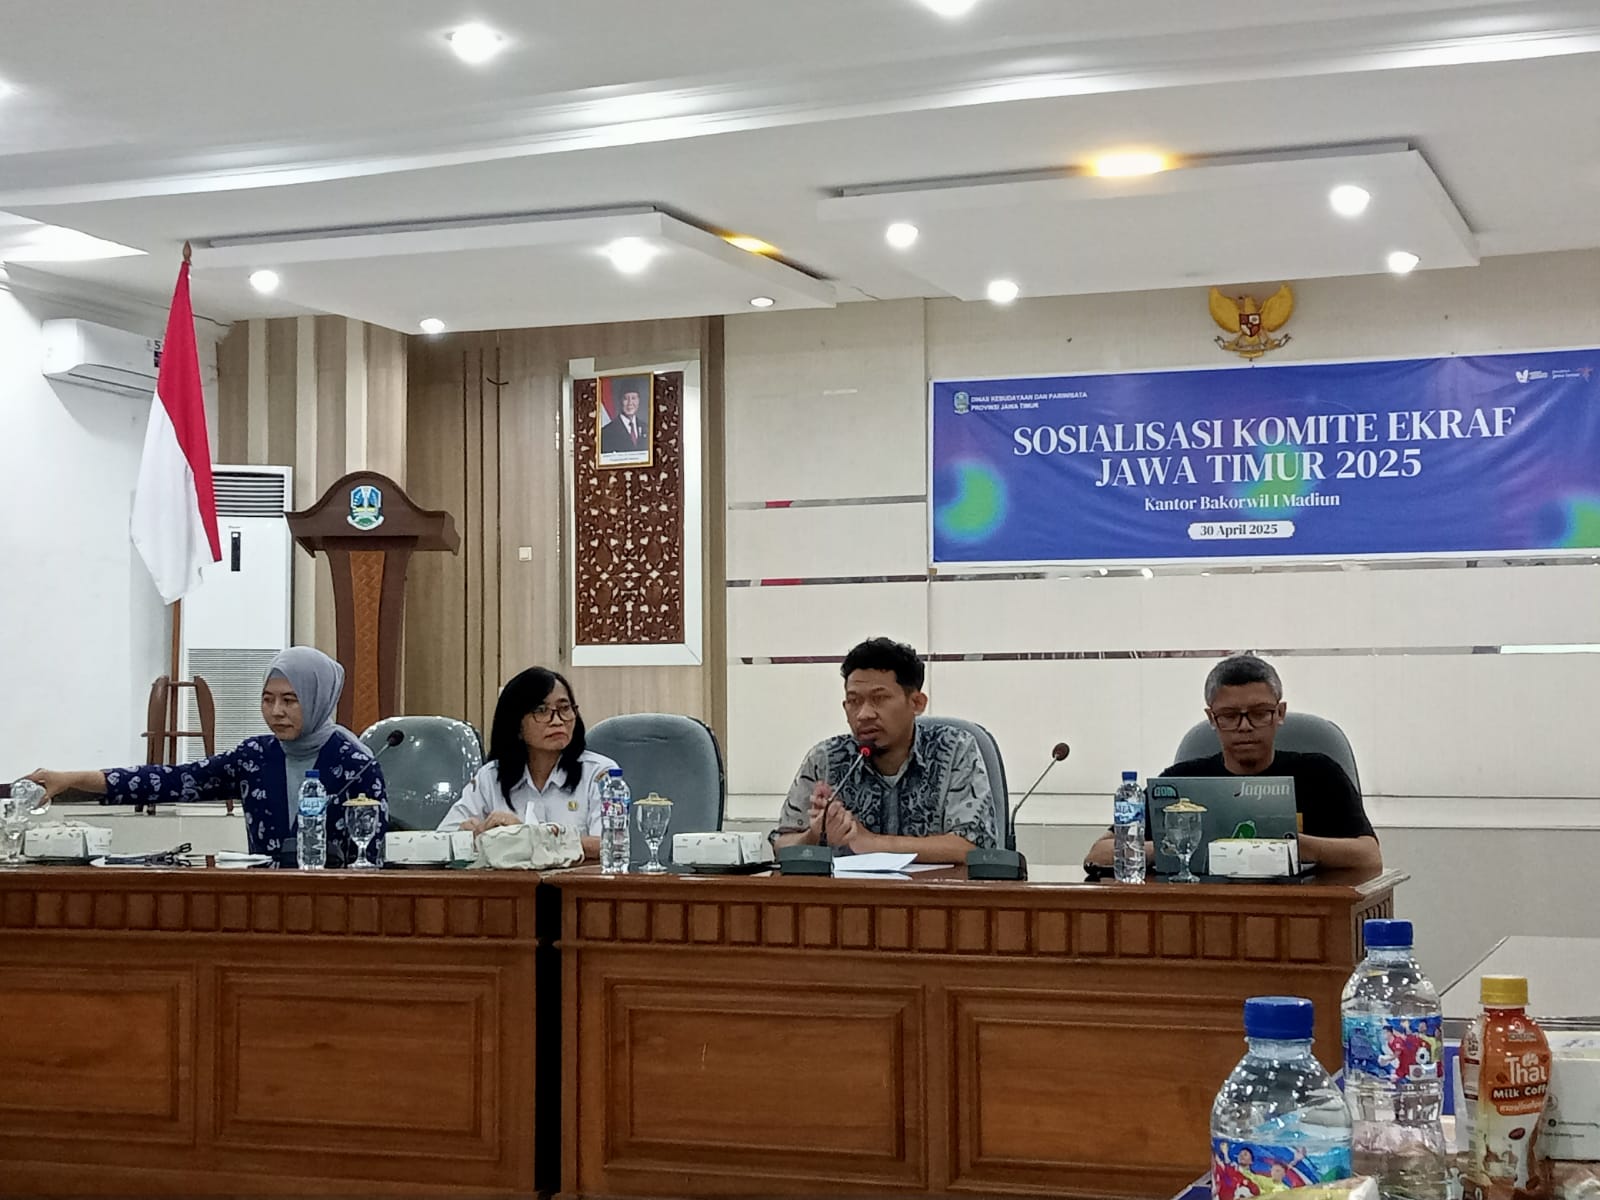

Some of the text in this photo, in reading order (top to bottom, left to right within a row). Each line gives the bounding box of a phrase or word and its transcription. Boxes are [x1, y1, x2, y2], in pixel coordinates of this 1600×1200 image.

[1013, 406, 1516, 456] SOSIALISASI KOMITE EKRAF
[1095, 448, 1422, 488] JAWA TIMUR 2025
[1145, 498, 1197, 511] Kantor
[1200, 495, 1269, 510] Bakorwil
[1282, 493, 1340, 507] Madiun
[1200, 524, 1278, 538] 30 April 2025
[1504, 1056, 1547, 1085] Thai
[1493, 1084, 1548, 1099] Milk Coff
